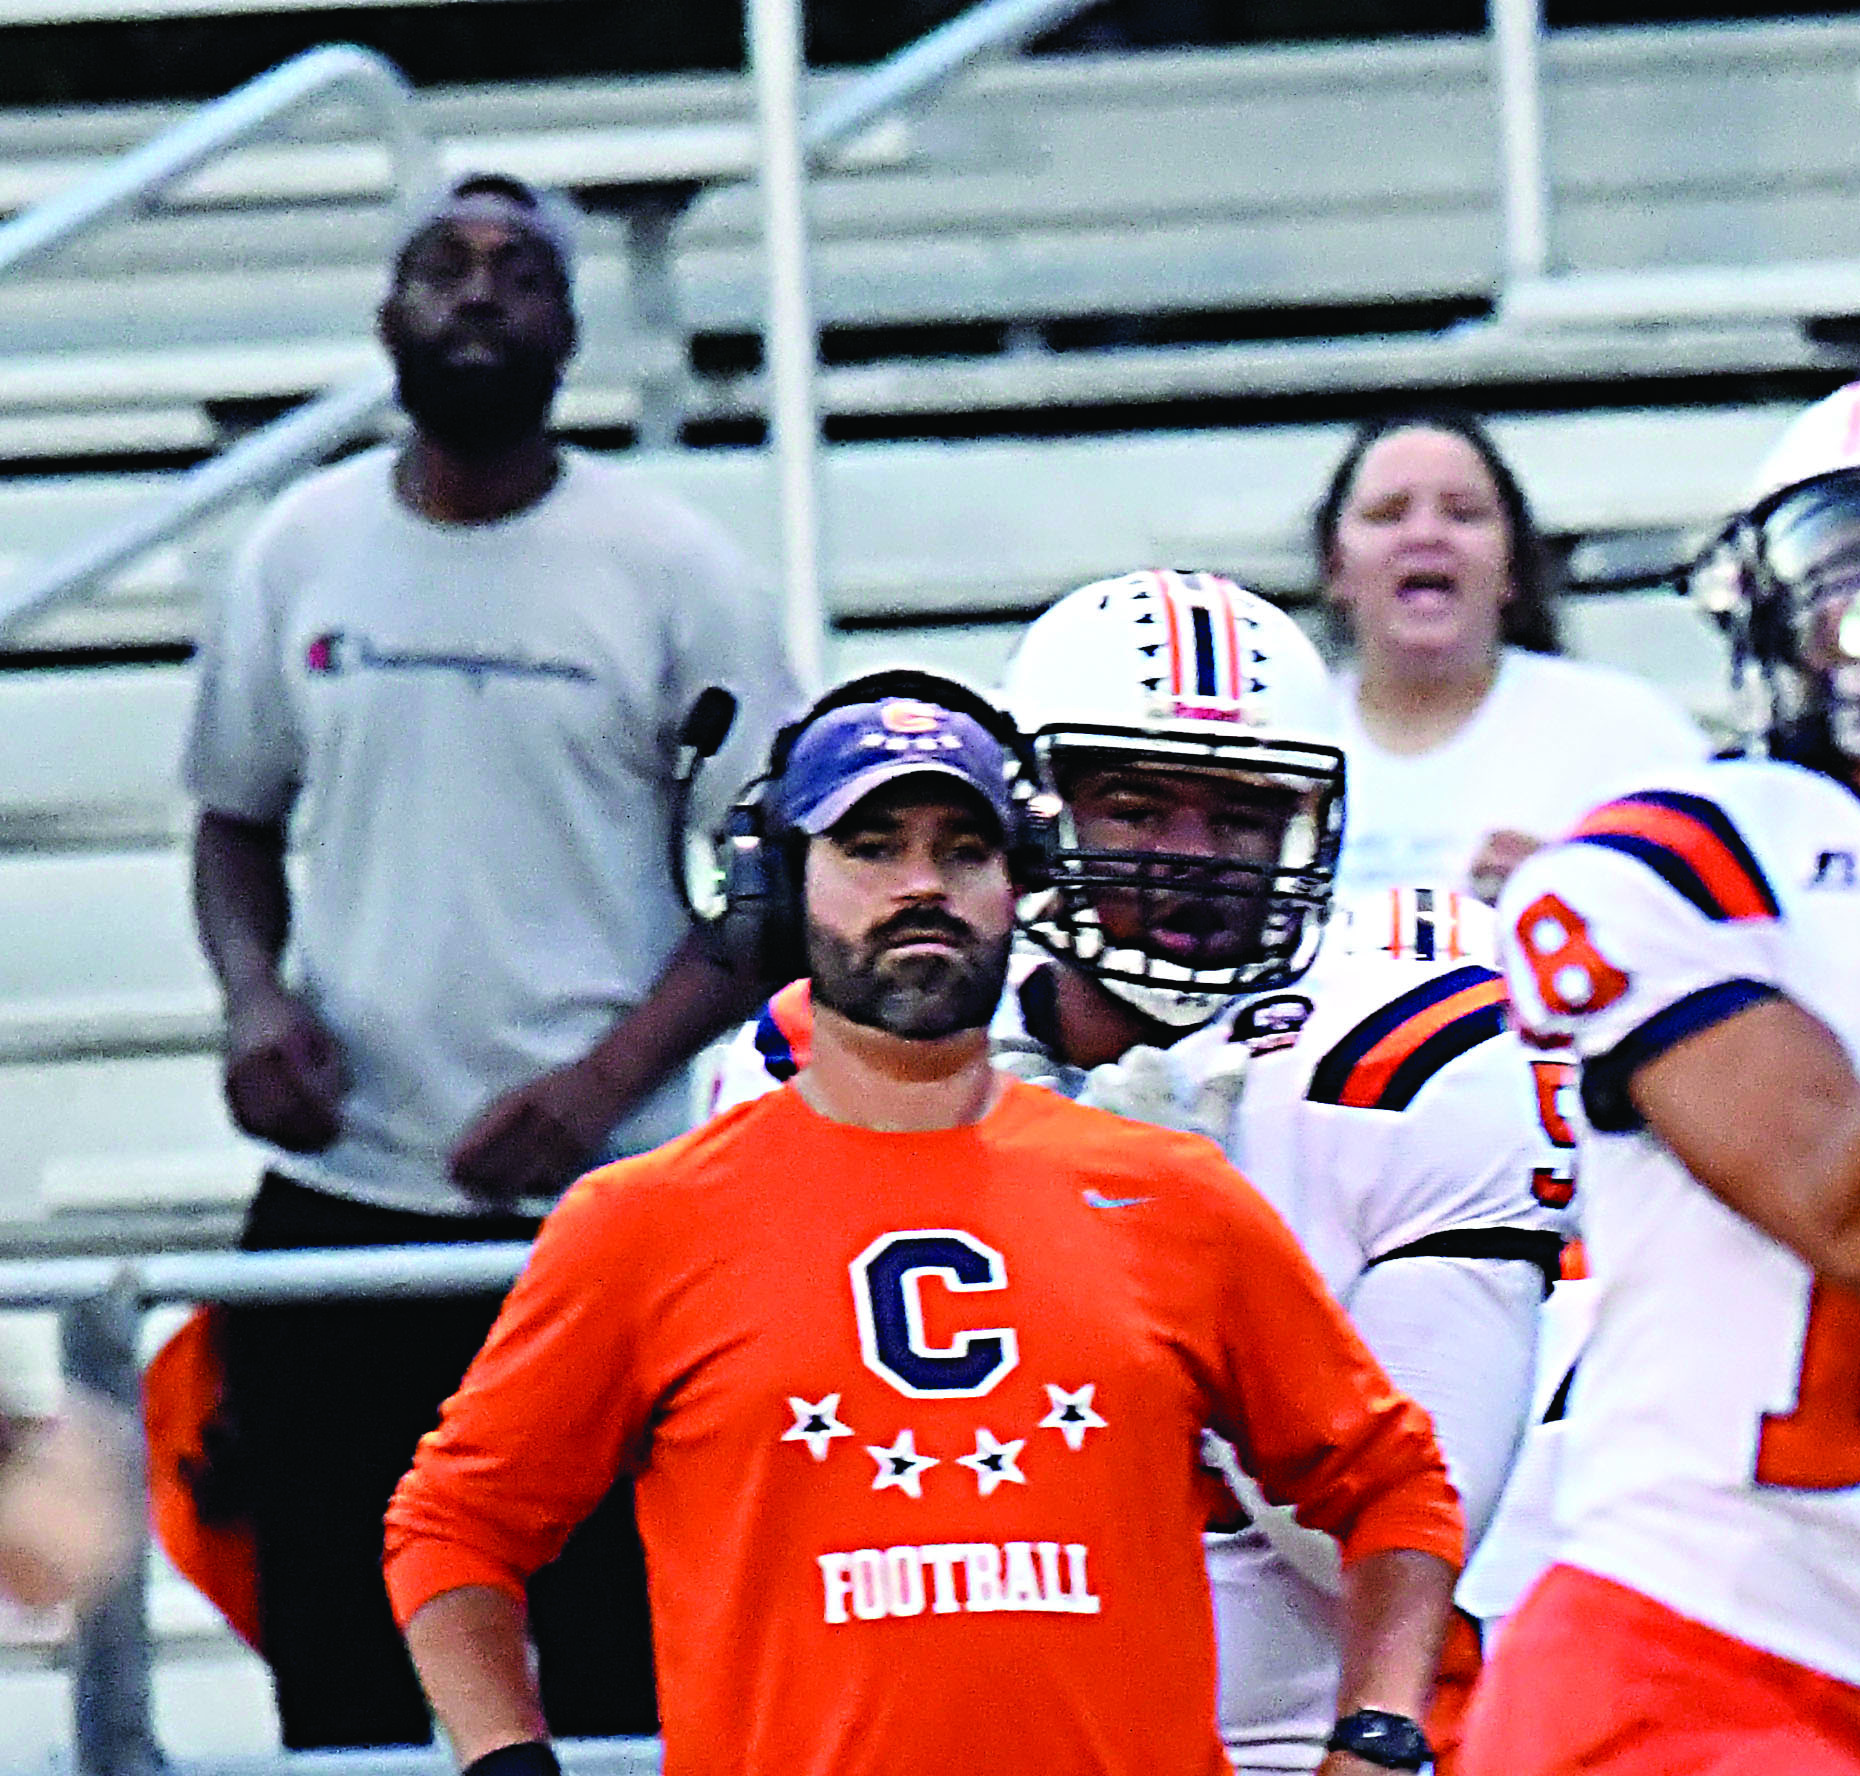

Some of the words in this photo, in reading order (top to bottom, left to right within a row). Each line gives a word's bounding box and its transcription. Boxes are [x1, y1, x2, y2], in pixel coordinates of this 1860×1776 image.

[1515, 893, 1629, 1014] 8
[848, 1228, 1020, 1399] C
[817, 1541, 1101, 1624] FOOTBALL
